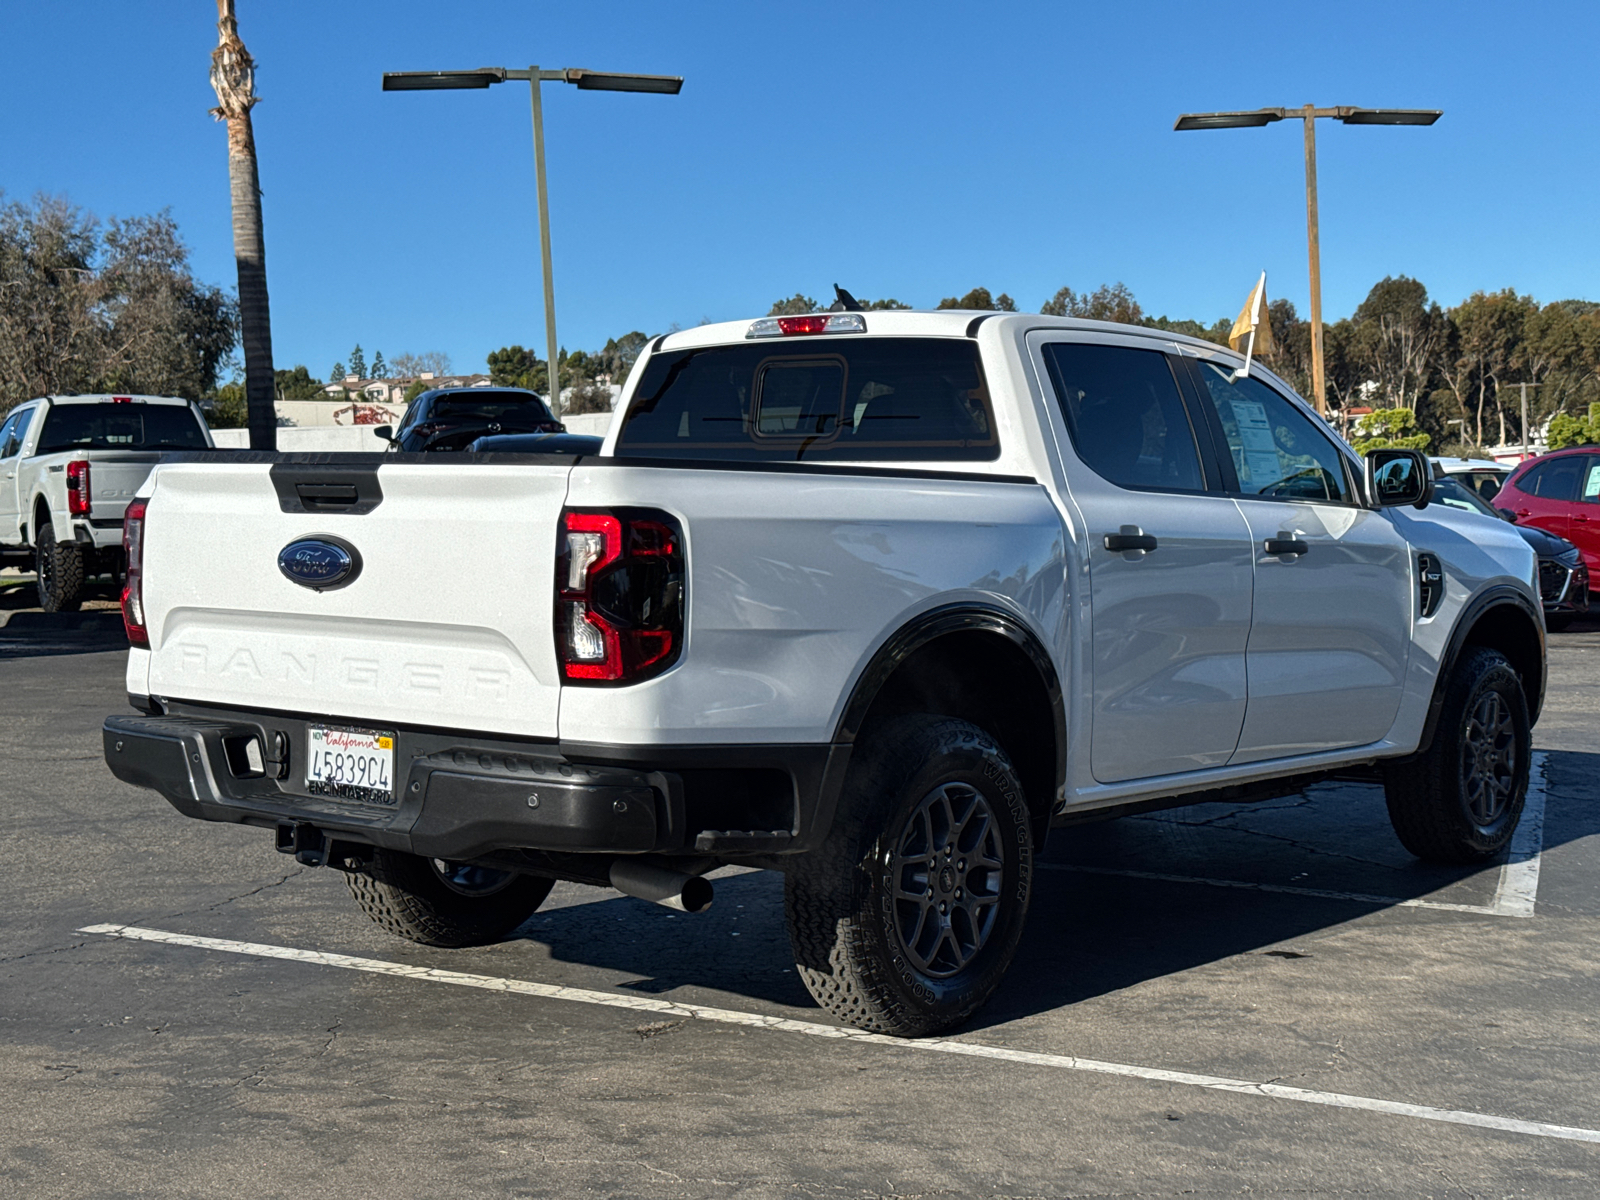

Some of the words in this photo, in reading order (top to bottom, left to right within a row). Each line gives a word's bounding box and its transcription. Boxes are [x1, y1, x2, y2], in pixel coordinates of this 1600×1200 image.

[178, 642, 512, 699] RANGER
[325, 730, 380, 752] California
[312, 749, 389, 789] 45839C4
[982, 759, 1030, 903] WRANGLER
